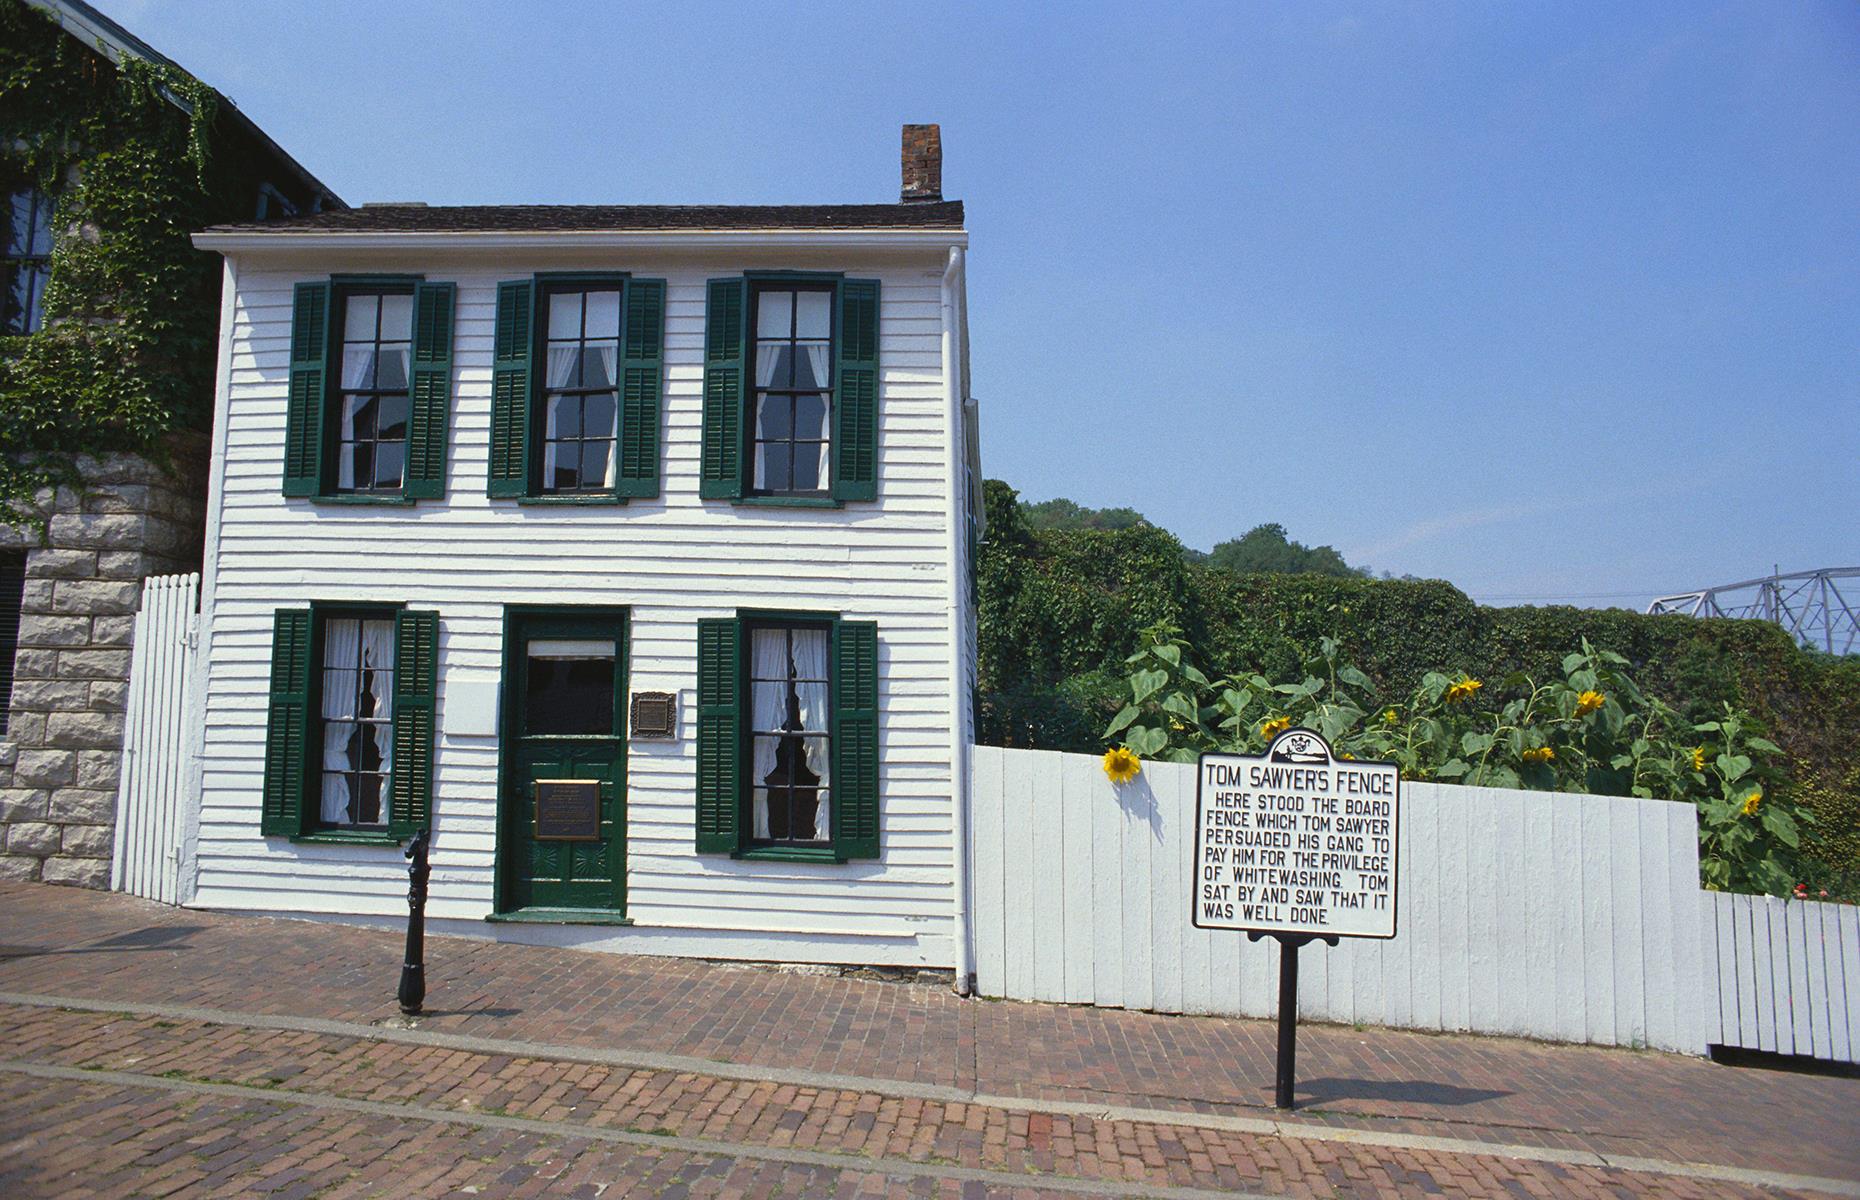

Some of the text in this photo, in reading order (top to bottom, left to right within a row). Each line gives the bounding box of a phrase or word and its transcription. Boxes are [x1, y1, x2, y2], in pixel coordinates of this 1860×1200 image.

[1206, 764, 1393, 795] TOM SAWYER'S FENCE
[1216, 792, 1389, 816] HERE STOOD THE BOARD
[1207, 810, 1389, 835] FENCE WHICH TOM SAWYER
[1206, 829, 1389, 853] PERSUADED HIS GANG TO
[1205, 848, 1388, 872] PAY HIM FOR THE PRIVILEGE
[1204, 866, 1222, 881] OF
[1359, 874, 1388, 891] TOM
[1204, 885, 1388, 909] SAT BY AND SAW THAT IT
[1204, 904, 1233, 919] WAS
[1243, 905, 1282, 922] WELL
